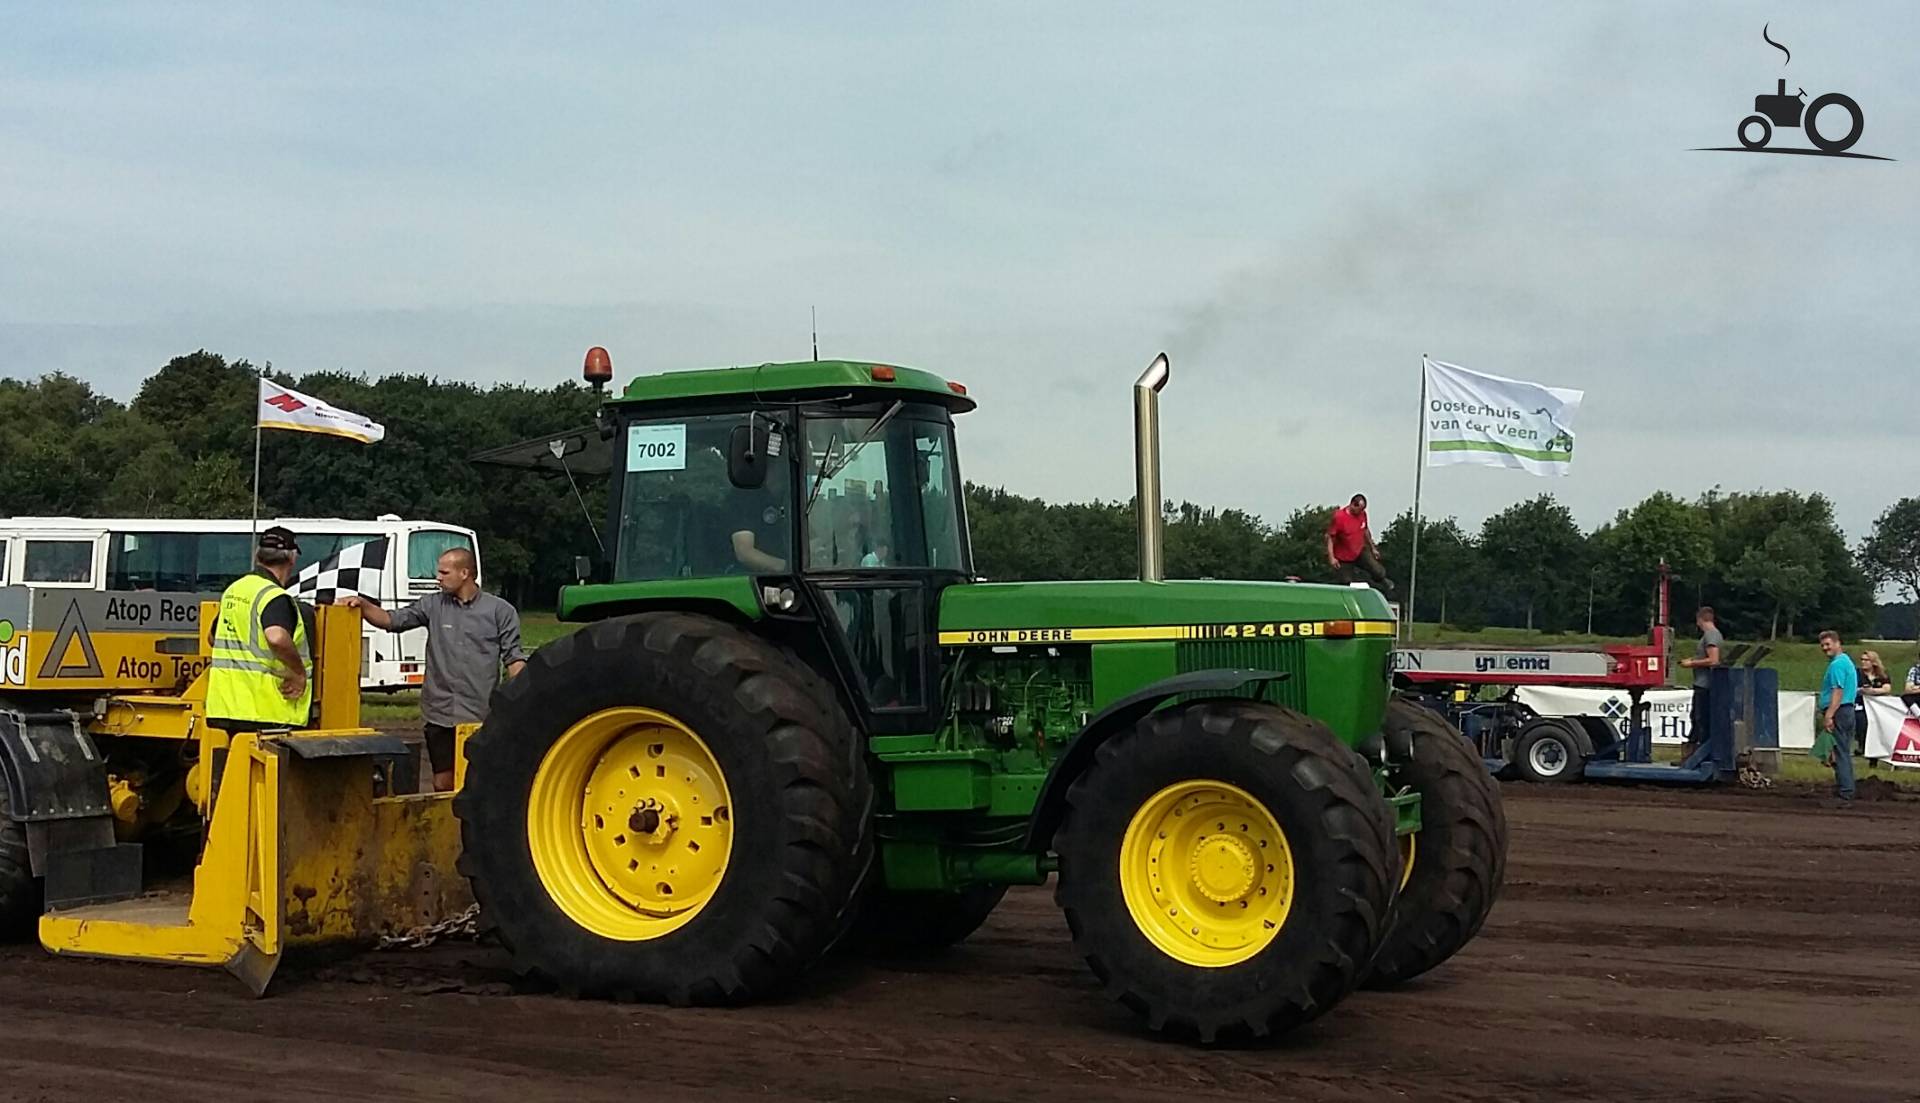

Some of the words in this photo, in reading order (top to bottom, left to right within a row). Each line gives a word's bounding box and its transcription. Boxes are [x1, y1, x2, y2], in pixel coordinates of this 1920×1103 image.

[1430, 400, 1521, 420] Oosterhuis
[1430, 419, 1460, 431] van
[1496, 423, 1538, 440] Veen
[638, 442, 676, 458] 7002
[106, 598, 151, 623] Atop
[160, 599, 200, 622] Rec
[968, 631, 1009, 642] JOHN
[1018, 630, 1072, 641] DEERE
[1223, 622, 1313, 638] 4240S
[116, 657, 162, 683] Atop
